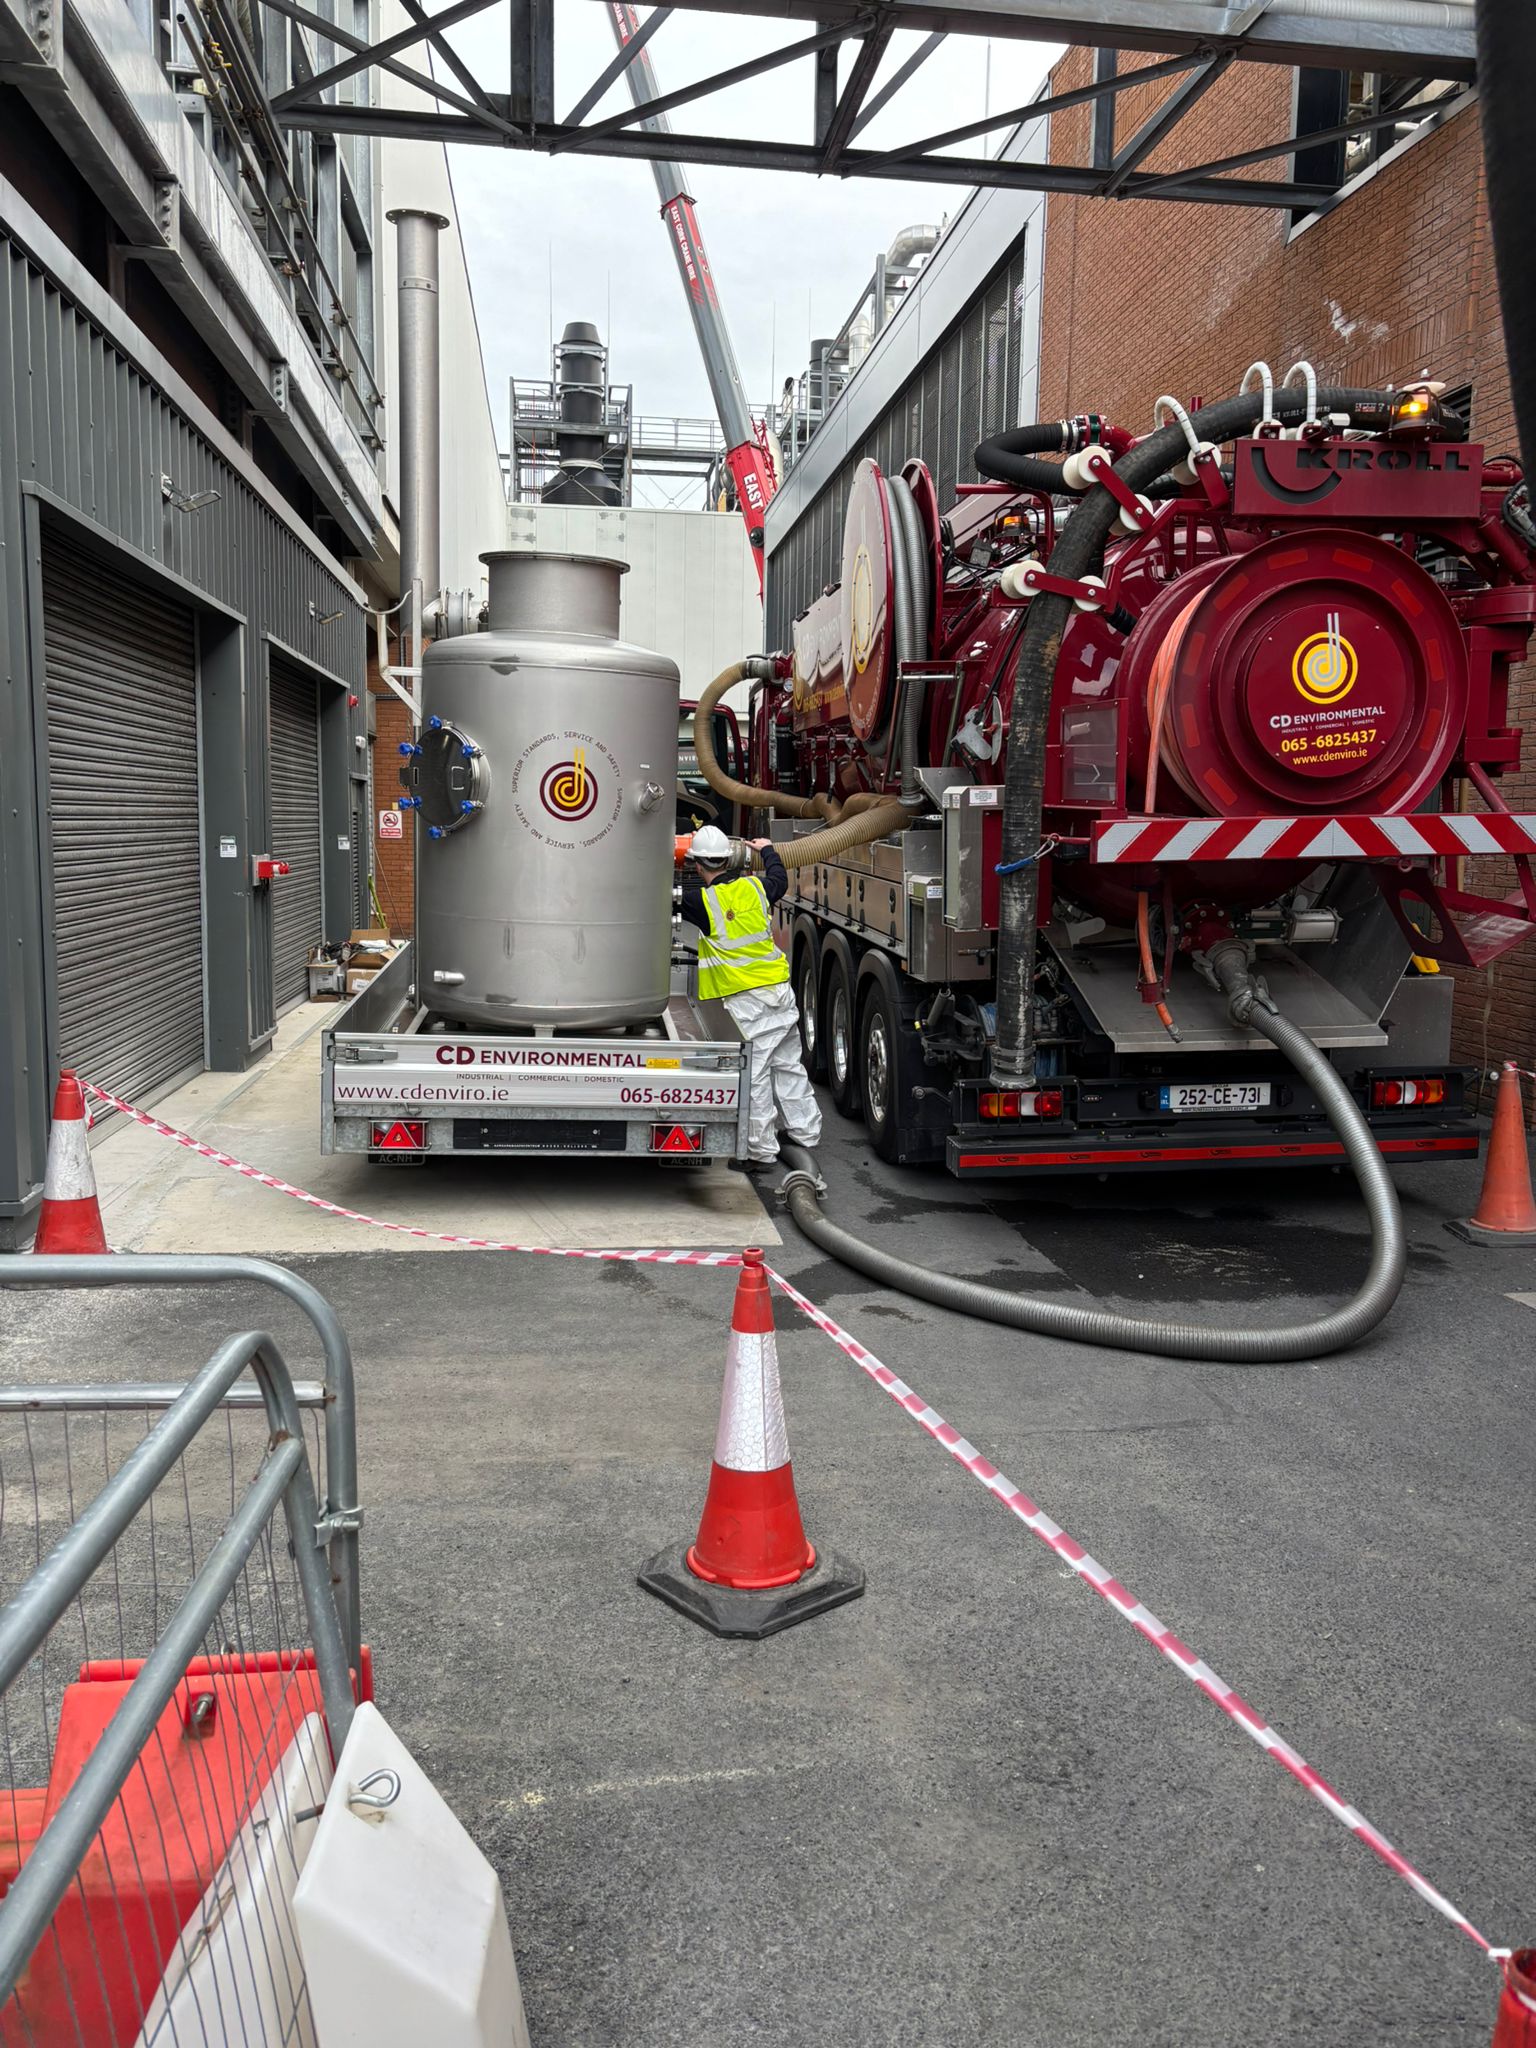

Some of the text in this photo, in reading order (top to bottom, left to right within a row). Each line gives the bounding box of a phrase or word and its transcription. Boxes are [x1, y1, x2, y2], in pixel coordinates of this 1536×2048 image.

[670, 205, 681, 223] EAST
[1296, 448, 1470, 471] KROLL
[743, 472, 764, 510] EAST
[1270, 706, 1386, 729] CD ENVIRONMENTAL
[1315, 722, 1345, 730] COMMERCIAL
[1281, 729, 1377, 752] 065 -6825437
[512, 731, 621, 794] SUPERIOR STANDARDS, SERVICE AND SAFETY
[1293, 748, 1368, 765] www.cdenviro.ie
[612, 787, 623, 822] SUPERIOR
[514, 803, 531, 829] SAFETY
[530, 828, 543, 840] AND
[544, 838, 575, 850] SERVICE
[436, 1045, 475, 1065] CD
[480, 1050, 647, 1068] ENVIRONMENTAL
[456, 1073, 504, 1081] INDUSTRIAL
[337, 1084, 509, 1101] www.cdenviro.ie
[620, 1087, 737, 1105] 065-6825437
[1179, 1087, 1260, 1106] 252-CE-731
